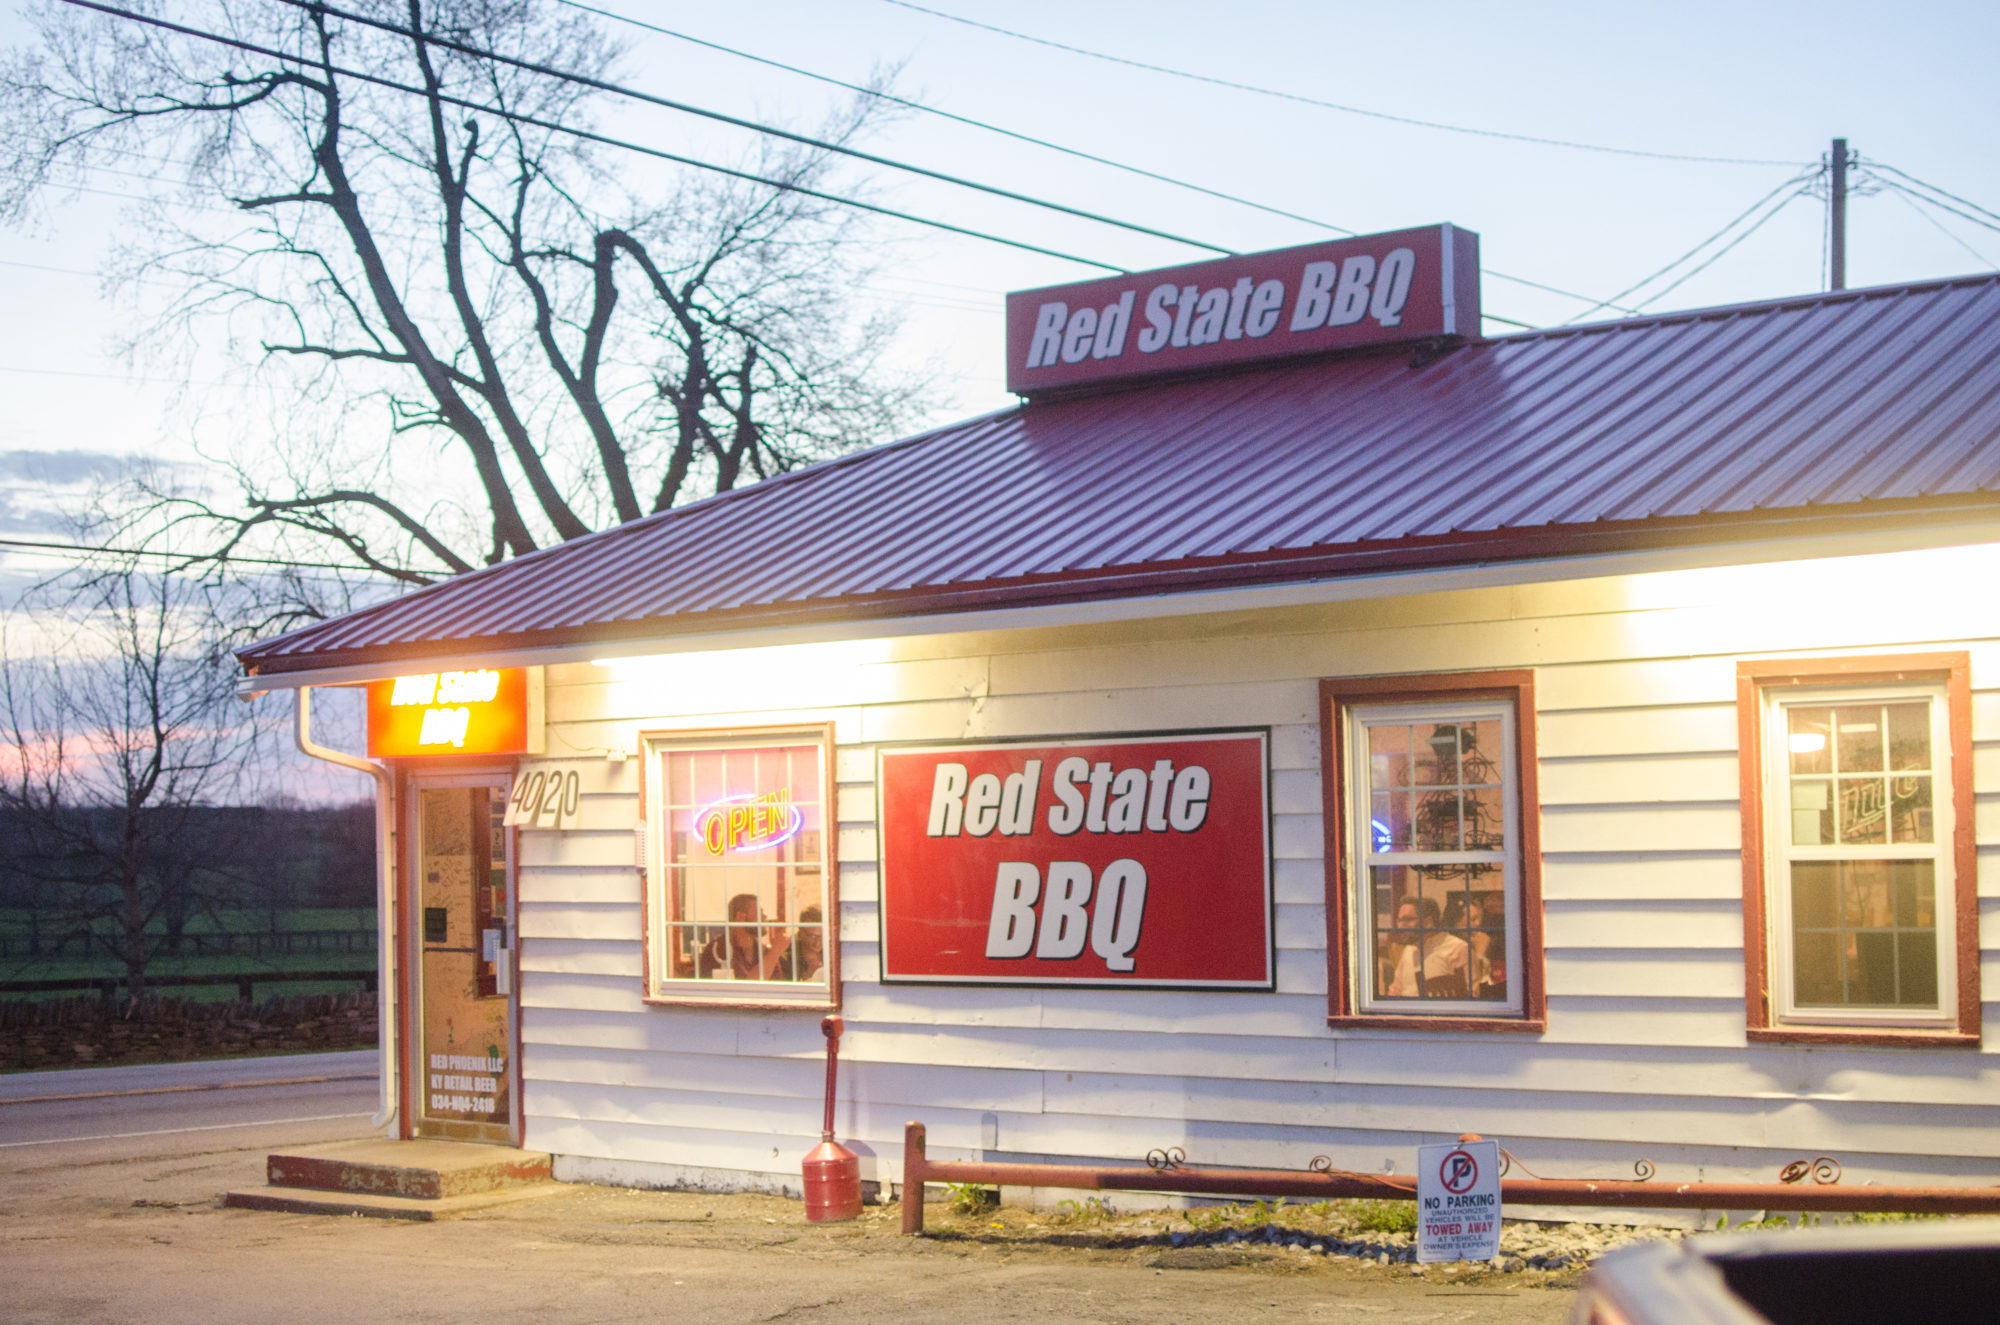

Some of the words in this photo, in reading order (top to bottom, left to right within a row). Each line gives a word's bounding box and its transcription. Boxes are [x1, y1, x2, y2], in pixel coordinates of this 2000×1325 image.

[1026, 290, 1136, 369] Red
[1137, 276, 1285, 354] State
[1290, 247, 1416, 333] BBQ
[510, 769, 580, 817] 4020
[926, 759, 1043, 838] Red
[1048, 756, 1212, 835] State
[704, 787, 788, 856] OPEN
[985, 858, 1148, 974] BBQ
[487, 1057, 503, 1073] LLC
[431, 1074, 443, 1089] KY
[1425, 1197, 1440, 1209] NO
[1447, 1193, 1495, 1208] PARKING
[1431, 1207, 1488, 1216] UNAUTHORIZED
[1425, 1216, 1462, 1224] VEHICLES
[1425, 1223, 1462, 1236] TOWED
[1468, 1221, 1493, 1234] AWAY
[1451, 1234, 1482, 1242] VEHICLE
